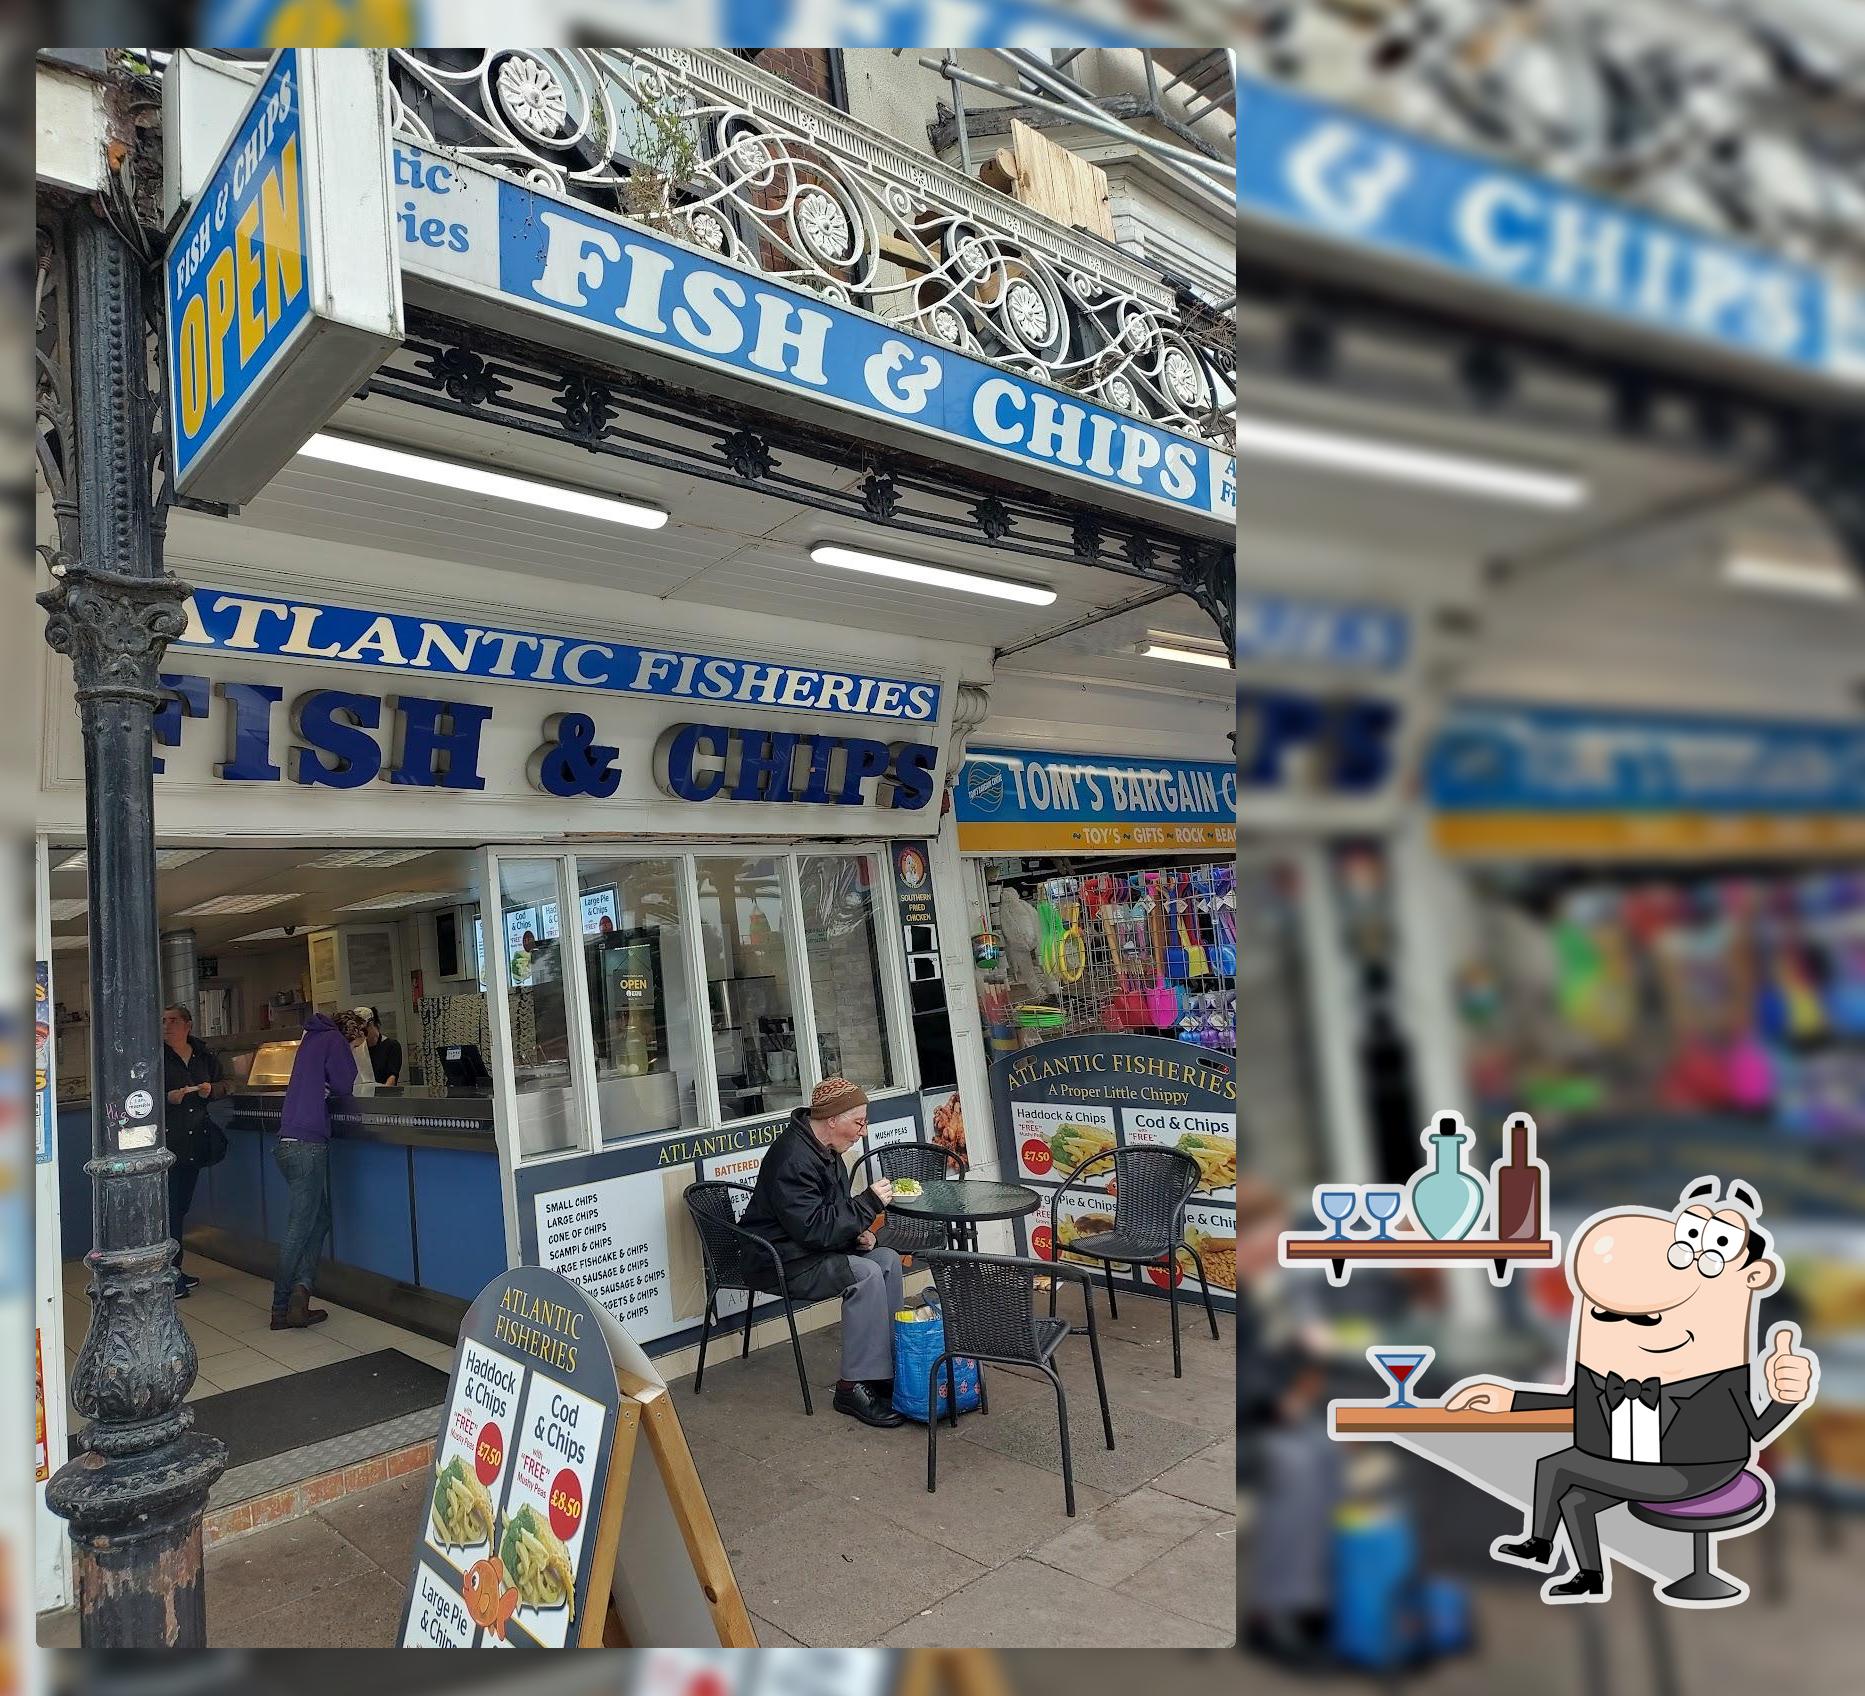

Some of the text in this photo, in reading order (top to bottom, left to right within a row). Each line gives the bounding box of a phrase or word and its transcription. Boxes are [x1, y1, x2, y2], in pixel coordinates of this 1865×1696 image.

[176, 69, 292, 300] FISH & CHIPS
[180, 131, 302, 439] OPEN
[532, 211, 1198, 500] FISH & CHIPS
[632, 650, 934, 719] FISHERIES
[527, 712, 623, 798] &
[653, 722, 939, 810] CHIPS
[1008, 761, 1104, 812] TOM'S
[1107, 766, 1219, 812] BARGAIN
[1082, 827, 1121, 845] TOY'S
[1134, 827, 1164, 844] GIFTS
[1175, 827, 1204, 843] ROCK
[900, 893, 932, 902] SOUTHERN
[908, 903, 926, 911] FRIED
[906, 913, 932, 922] CHICKEN
[620, 980, 647, 990] OPEN
[1008, 1053, 1236, 1100] ATLANTIC FISHERIES
[1049, 1084, 1189, 1105] A Proper Little Chippy
[1017, 1108, 1106, 1124] Haddock & Chips
[1135, 1114, 1229, 1135] Cod & Chips
[875, 1127, 908, 1140] MUSHY PEAS
[658, 1132, 744, 1165] ATLANTIC
[1024, 1151, 1050, 1162] £7.50
[714, 1159, 760, 1177] BATTERED
[545, 1194, 598, 1213] SMALL CHIPS
[1058, 1194, 1075, 1206] Pie
[1077, 1199, 1085, 1208] &
[1087, 1199, 1117, 1212] Chips
[547, 1208, 599, 1228] LARGE CHIPS
[1197, 1213, 1207, 1225] &
[549, 1222, 607, 1244] CONE OF CHIPS
[549, 1236, 613, 1260] SCAMPI & CHIPS
[580, 1250, 618, 1269] FISHCAKE
[619, 1249, 626, 1259] &
[626, 1243, 649, 1256] CHIPS
[582, 1267, 618, 1284] SAUSAGE
[619, 1264, 626, 1274] &
[627, 1258, 649, 1272] CHIPS
[600, 1278, 636, 1296] SAUSAGE
[637, 1275, 643, 1285] &
[644, 1269, 666, 1283] CHIPS
[629, 1293, 635, 1303] &
[637, 1287, 659, 1301] CHIPS
[500, 1286, 584, 1340] ATLANTIC
[619, 1312, 625, 1322] &
[627, 1305, 649, 1319] CHIPS
[494, 1314, 578, 1373] FISHERIES
[465, 1349, 516, 1395] Haddock
[464, 1377, 507, 1418] & Chips
[552, 1394, 579, 1428] Cod
[534, 1416, 586, 1464] & Chips
[477, 1441, 501, 1466] £7.50
[517, 1472, 547, 1498] Mushy Peas
[551, 1489, 581, 1518] £8.50
[422, 1576, 468, 1636] Large Pie
[420, 1609, 429, 1632] &
